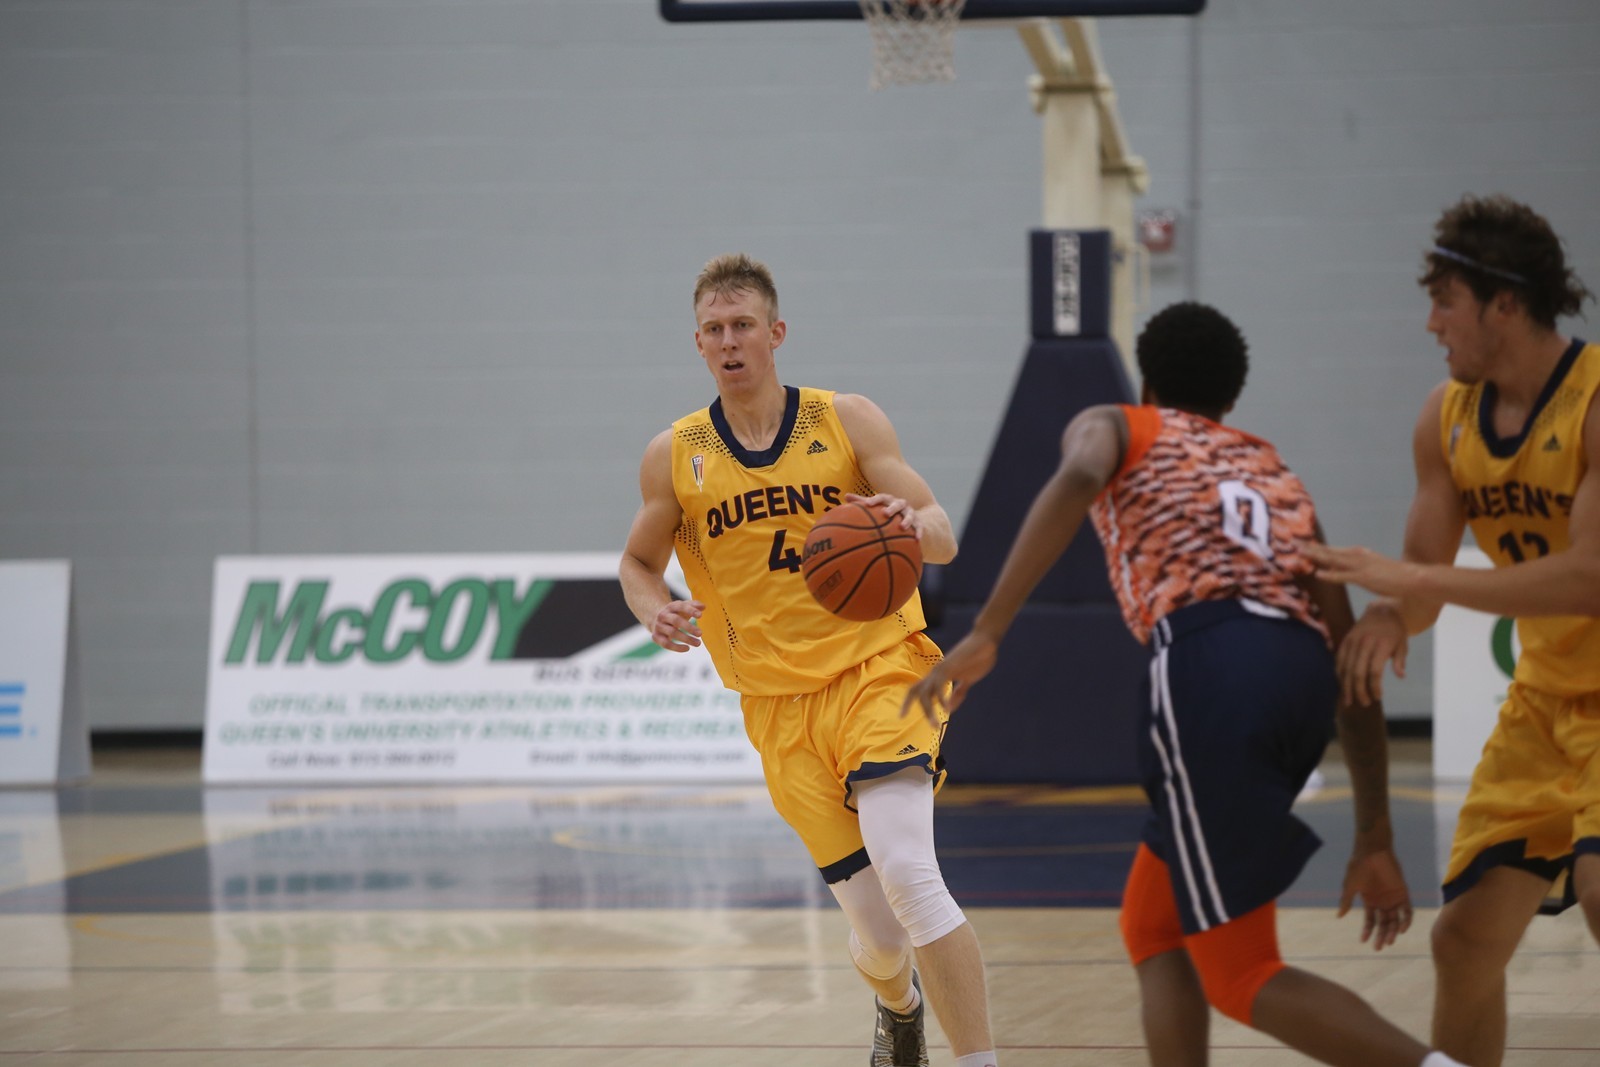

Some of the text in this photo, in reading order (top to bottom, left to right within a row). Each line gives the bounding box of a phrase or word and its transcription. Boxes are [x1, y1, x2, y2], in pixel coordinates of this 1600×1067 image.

[706, 484, 842, 539] QUEEN'S
[1217, 480, 1275, 560] 0
[768, 529, 803, 574] 4
[223, 576, 556, 665] McCOY
[535, 664, 581, 682] BUS
[592, 664, 689, 682] SERVICE
[361, 692, 574, 713] TRANSPORTATION
[583, 692, 705, 712] PROVIDER
[219, 722, 325, 745] QUEEN'S
[333, 721, 475, 743] UNIVERSITY
[480, 720, 607, 741] ATHLETICS
